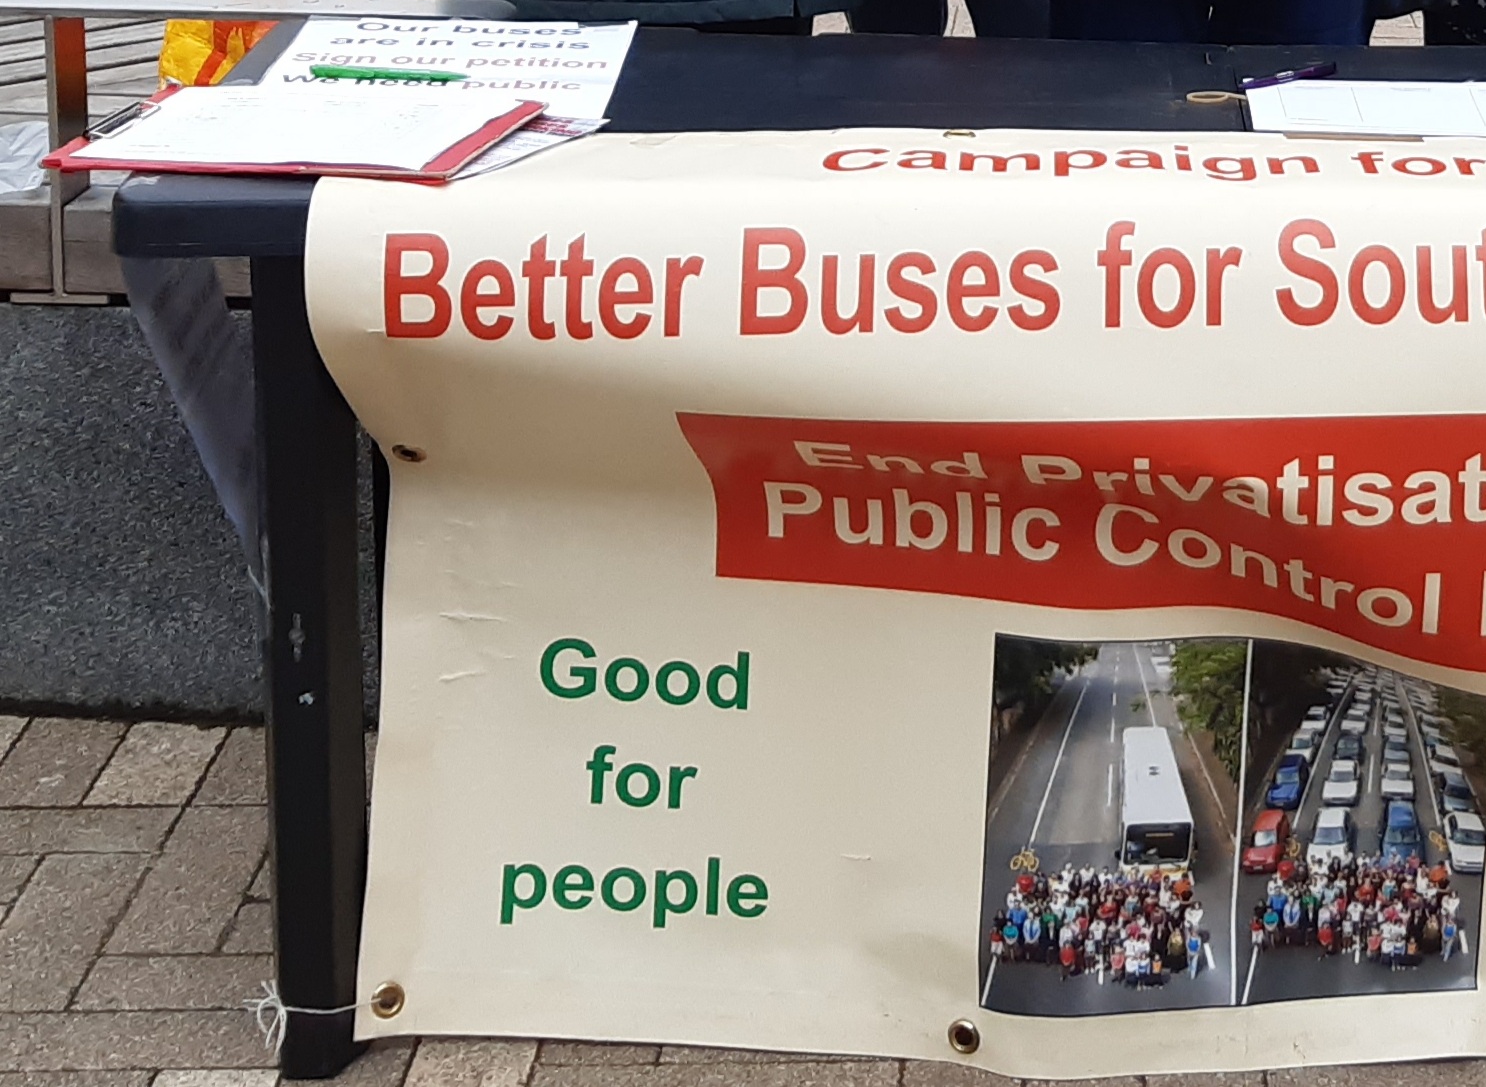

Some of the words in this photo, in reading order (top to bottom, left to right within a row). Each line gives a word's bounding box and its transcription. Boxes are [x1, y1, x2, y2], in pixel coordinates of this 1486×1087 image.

[330, 37, 399, 46] are
[416, 37, 455, 46] in
[471, 37, 591, 49] crisis
[357, 22, 438, 33] Our
[452, 24, 582, 36] buses
[292, 52, 376, 66] Sign
[391, 56, 455, 66] our
[465, 56, 608, 69] petition
[462, 79, 582, 91] public
[822, 143, 1321, 181] Campaign
[1351, 151, 1486, 177] for
[383, 232, 705, 341] Better
[739, 226, 1061, 336] Buses
[1097, 220, 1243, 329] for
[793, 440, 988, 480] End
[762, 480, 1062, 562] Public
[1095, 502, 1441, 636] Control
[539, 637, 750, 711] Good
[586, 744, 698, 810] for
[500, 856, 769, 929] people
